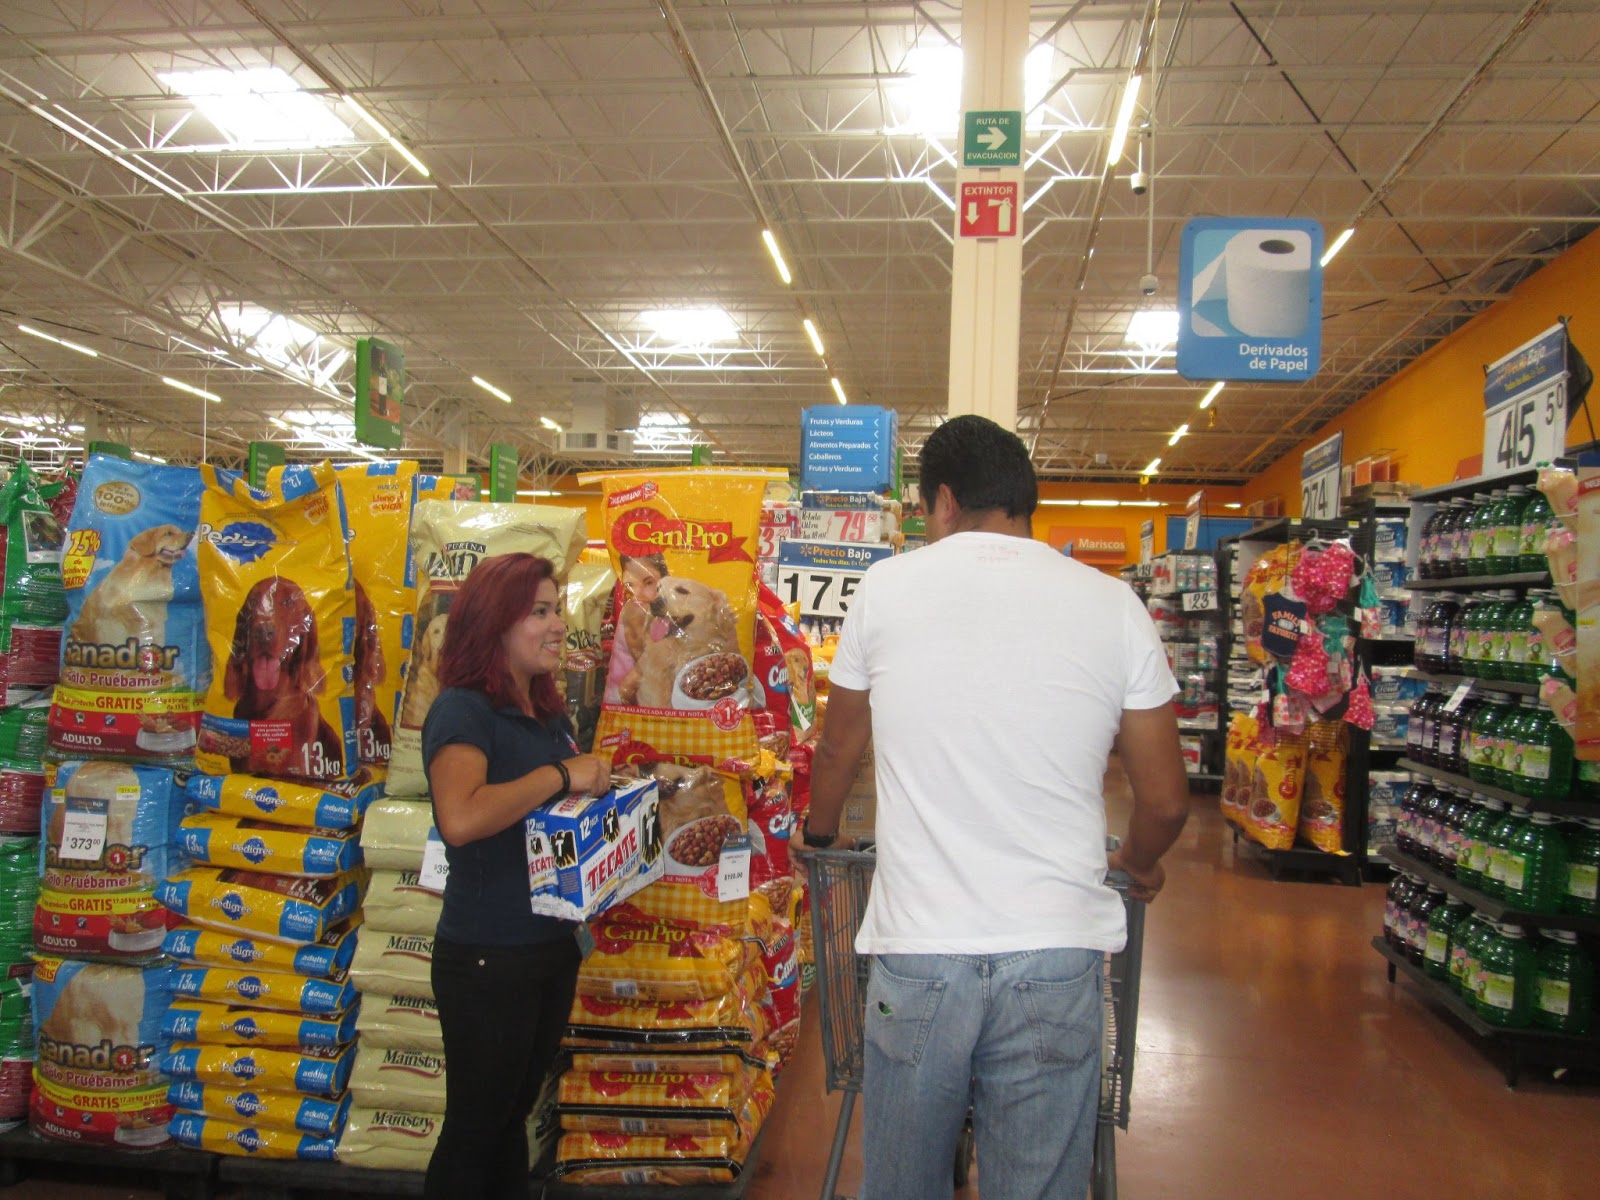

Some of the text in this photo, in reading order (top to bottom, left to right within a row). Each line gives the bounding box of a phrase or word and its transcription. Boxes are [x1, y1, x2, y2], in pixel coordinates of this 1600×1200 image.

[967, 152, 1017, 160] EVACUACION
[965, 186, 1013, 195] EXTINTOR
[1239, 343, 1308, 356] Derivados
[1249, 358, 1308, 373] de Papel
[810, 418, 828, 426] Frutas
[835, 418, 863, 426] Verduras
[810, 429, 834, 437] Lácteos
[1497, 401, 1536, 469] 45
[809, 441, 871, 450] Alimentos Preparados
[809, 453, 842, 461] Caballeros
[849, 496, 867, 504] Bajo
[627, 522, 728, 548] CanPro
[834, 511, 866, 542] 79
[69, 529, 102, 556] 15%
[445, 542, 486, 553] PURINA
[1079, 538, 1126, 549] Mariscos
[812, 546, 872, 561] Precio Bajo
[1192, 593, 1210, 610] 23
[90, 672, 164, 687] Pruébame!
[95, 696, 144, 710] GRATIS
[62, 732, 102, 746] ADULTO
[301, 741, 340, 776] 13kg
[199, 778, 216, 799] 13kg
[244, 789, 349, 814] Pedigree adulto
[526, 818, 536, 836] 12
[580, 816, 591, 841] 12
[70, 837, 93, 850] 373
[232, 842, 274, 858] Pedigree
[586, 827, 638, 894] TECATE
[618, 853, 640, 880] LIGHT
[64, 874, 133, 889] Pruébame!
[69, 898, 113, 912] GRATIS
[164, 885, 182, 907] 13kg
[210, 896, 313, 924] Pedigree adulto
[43, 934, 77, 948] ADULTO
[605, 924, 686, 943] CanPro
[171, 935, 191, 954] 13kg
[387, 936, 433, 953] Mainst
[220, 944, 327, 964] Pedigree adulto
[177, 973, 196, 992] 13kg
[226, 980, 333, 1000] Pedigree adulto
[172, 1055, 191, 1073] 13kg
[221, 1061, 328, 1080] Pedigree adulto
[383, 1049, 442, 1074] Mainstay
[66, 1071, 140, 1087] Pruébame!
[179, 1081, 199, 1101] 13kg
[73, 1094, 120, 1109] GRATIS
[225, 1095, 329, 1120] Pedigree adulto
[45, 1122, 81, 1140] ADULTO
[179, 1119, 197, 1139] 13kg
[371, 1111, 430, 1133] Mainstay
[226, 1131, 270, 1147] Pedigree
